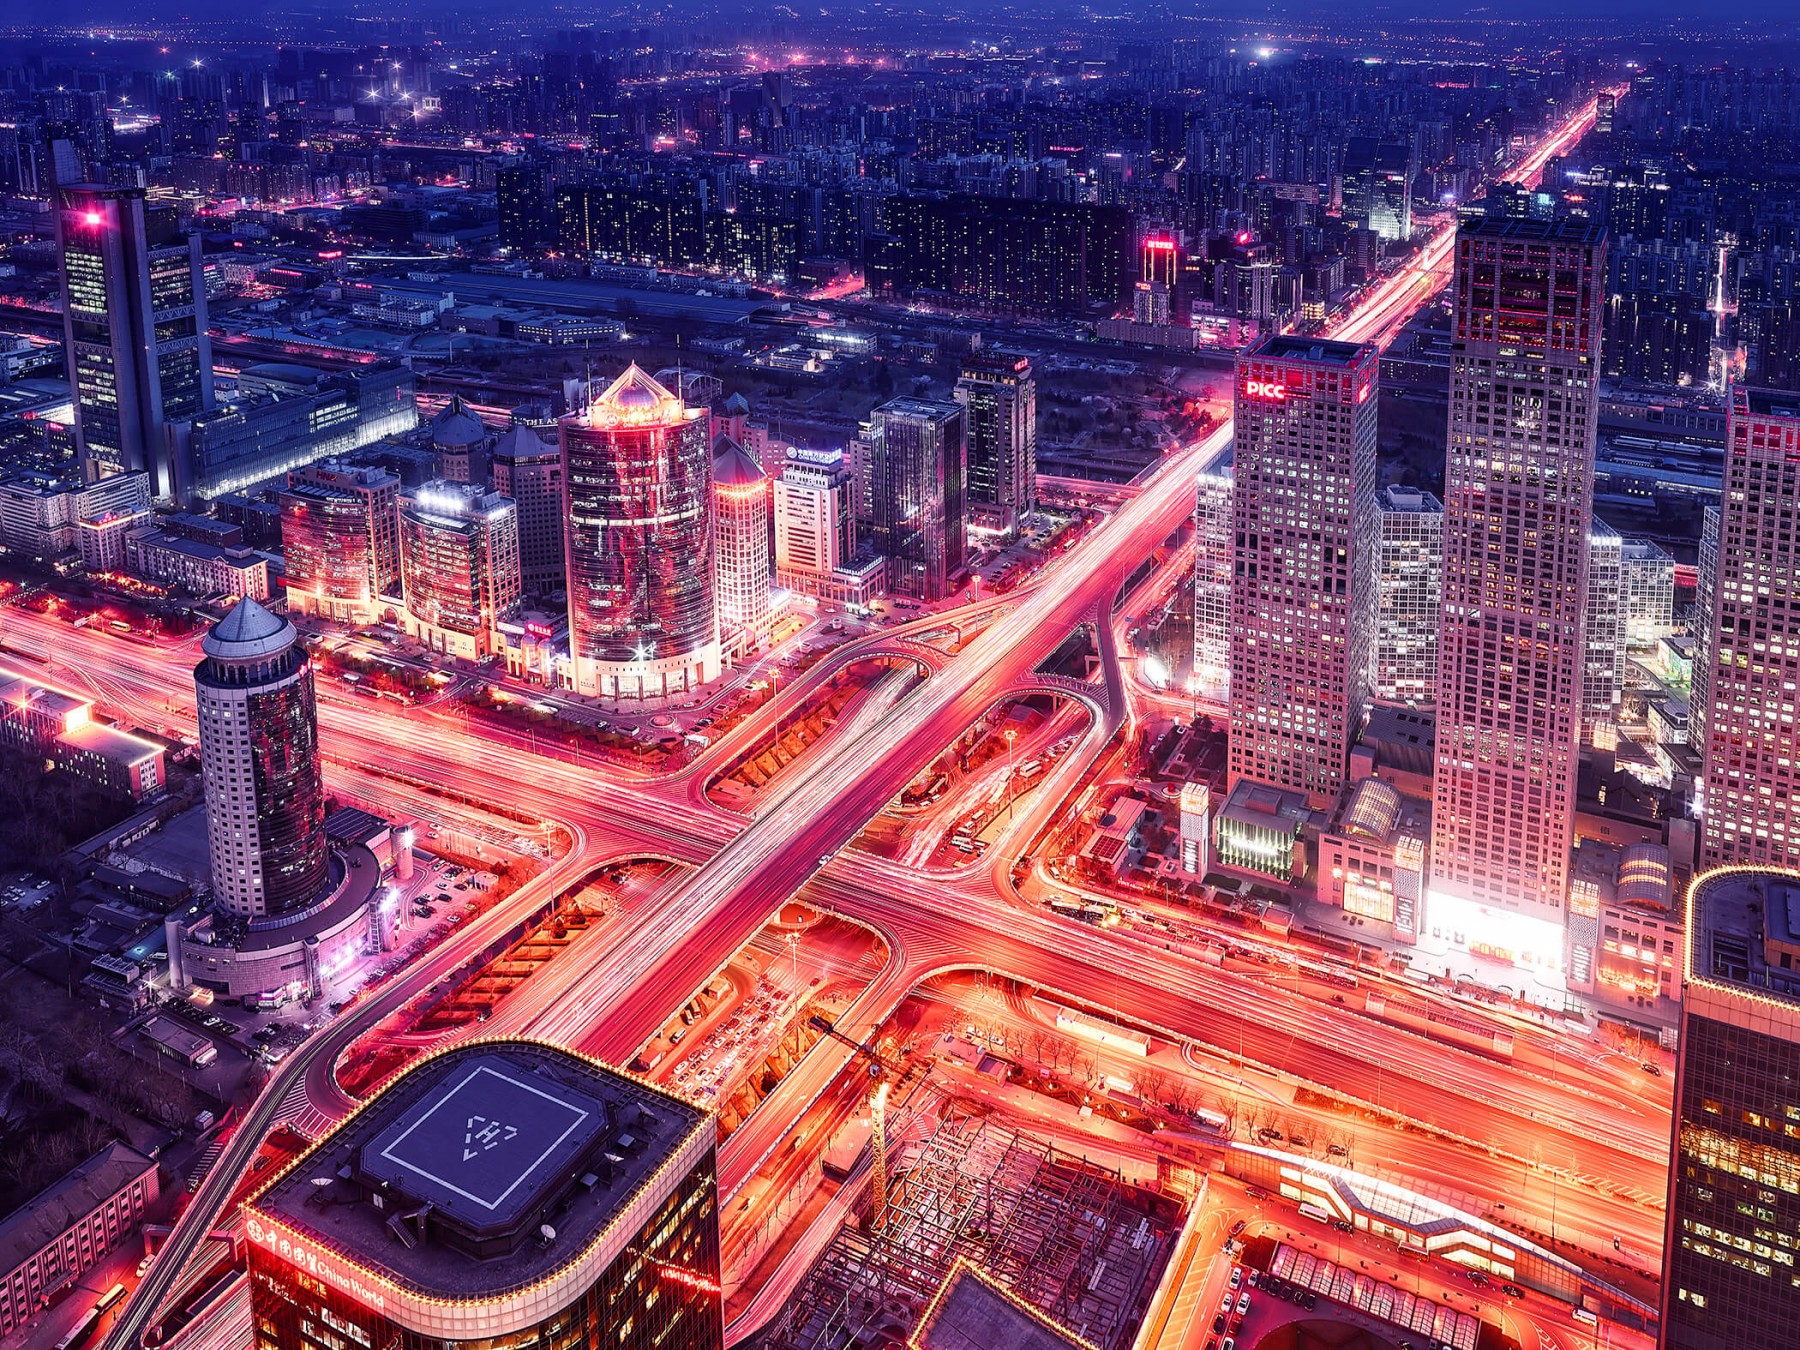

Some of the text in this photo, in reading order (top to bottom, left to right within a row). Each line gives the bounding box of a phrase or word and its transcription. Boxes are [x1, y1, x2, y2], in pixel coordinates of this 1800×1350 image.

[1247, 382, 1284, 399] PICC
[475, 1125, 501, 1144] H
[317, 1261, 349, 1287] China
[350, 1279, 384, 1308] World
